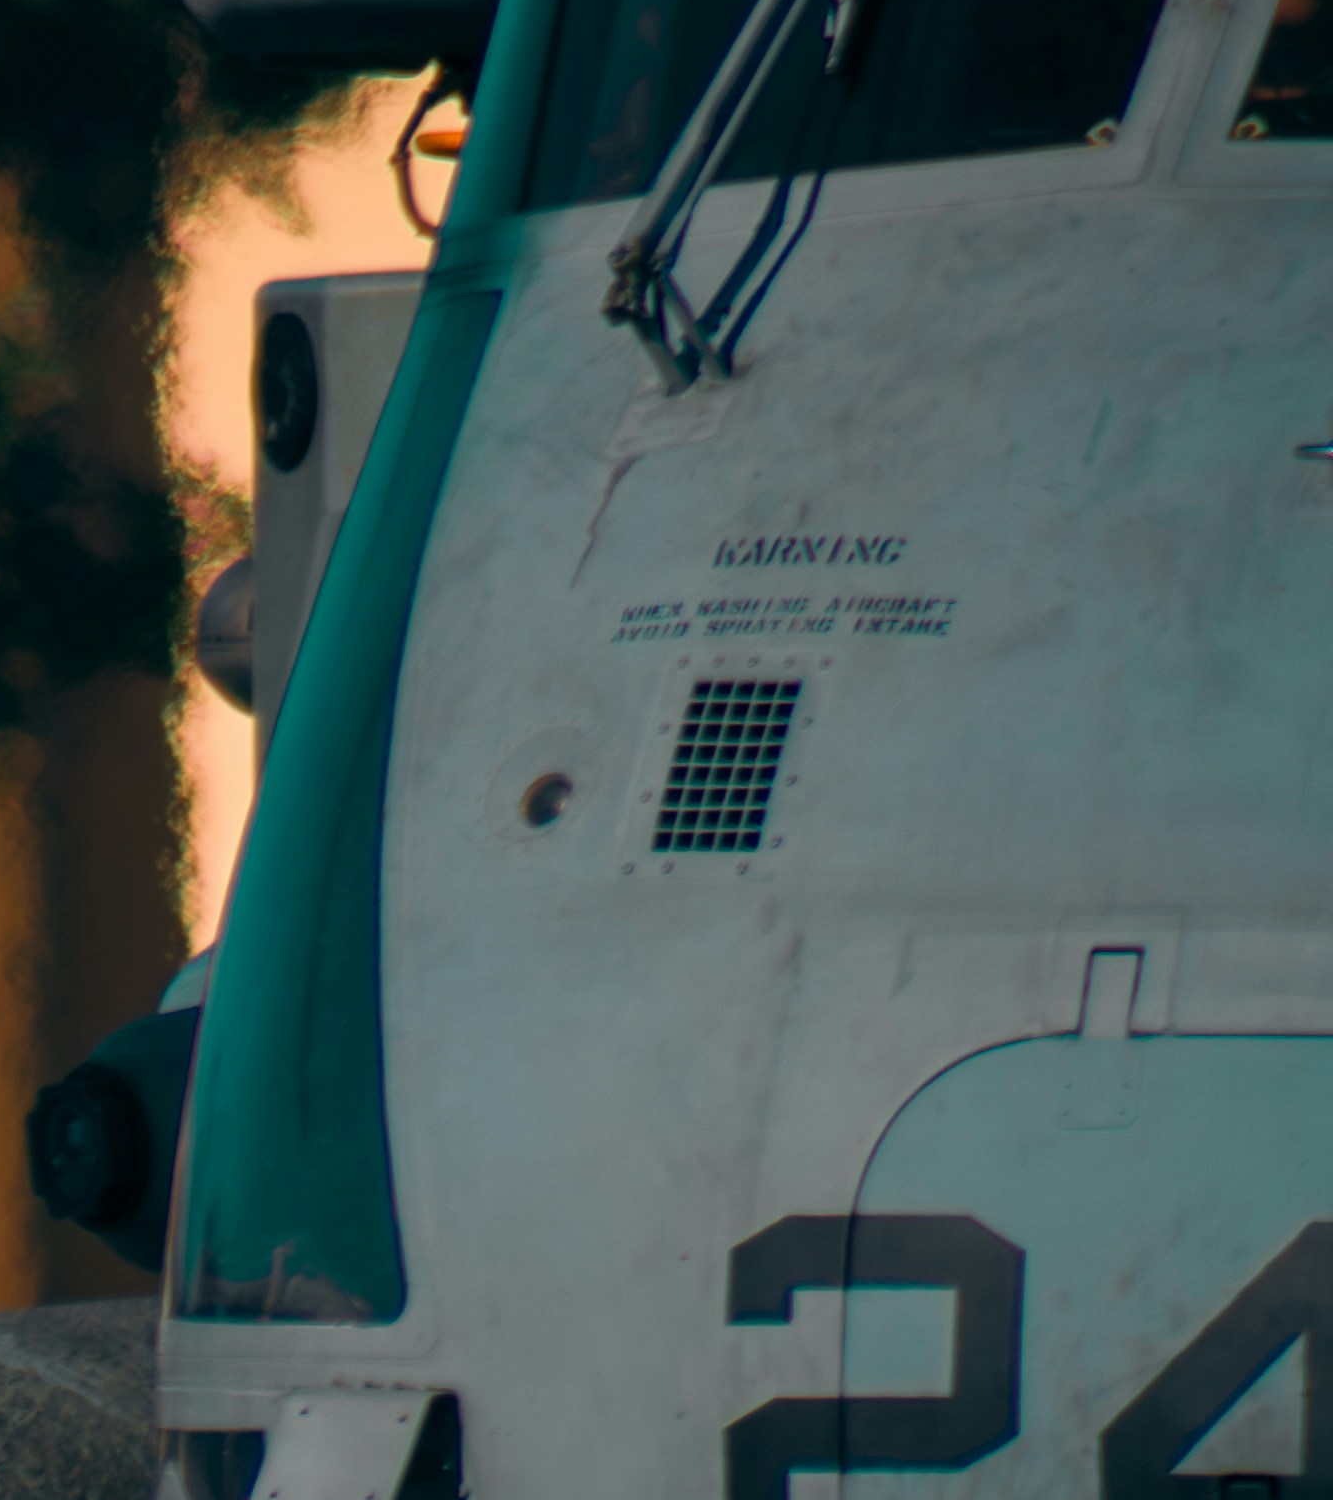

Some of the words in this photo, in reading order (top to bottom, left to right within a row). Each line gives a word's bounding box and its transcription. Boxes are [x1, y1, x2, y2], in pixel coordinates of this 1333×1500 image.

[713, 534, 908, 567] WARNING
[620, 601, 684, 623] WHEN
[696, 598, 809, 617] WASHING
[824, 597, 958, 615] AIRCRAFT
[610, 621, 691, 643] AVOID
[852, 617, 951, 636] INTAKE
